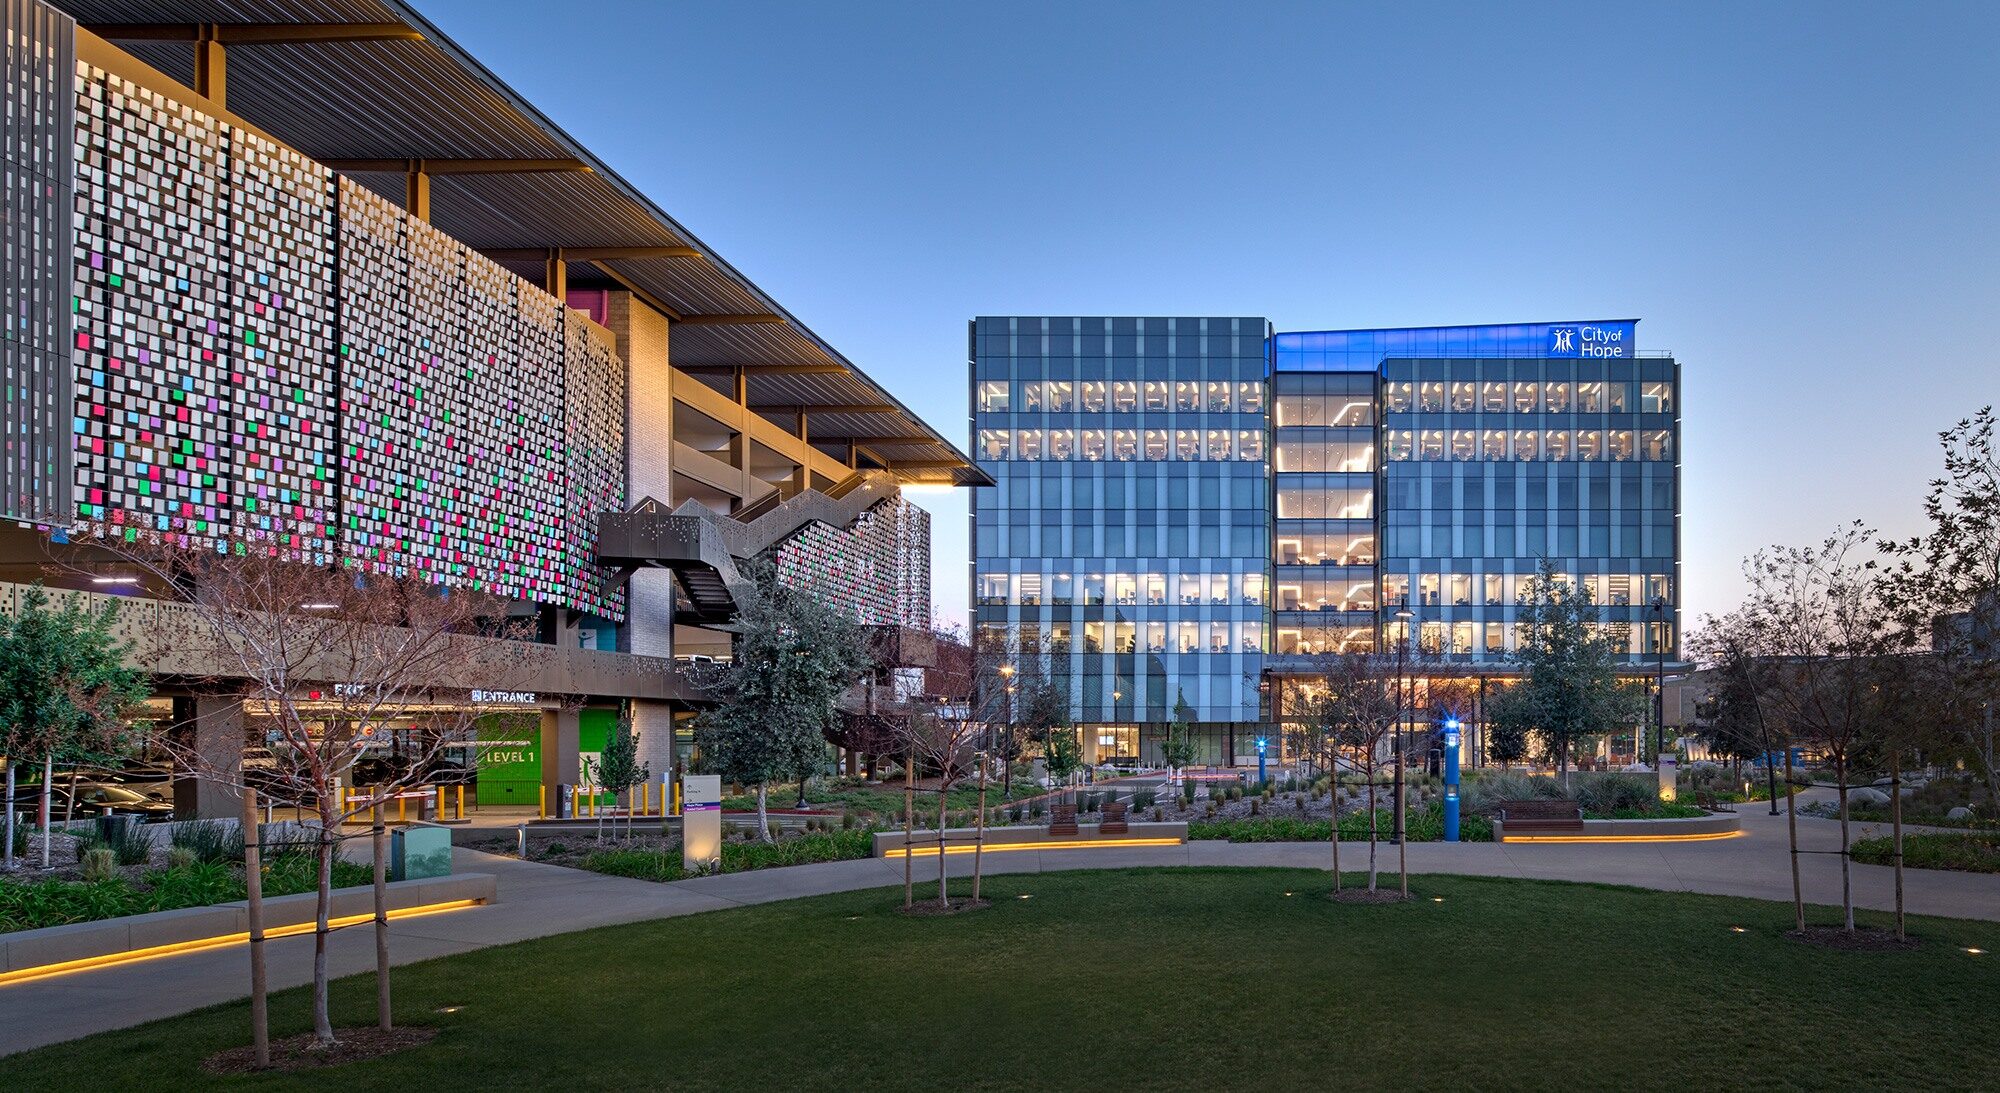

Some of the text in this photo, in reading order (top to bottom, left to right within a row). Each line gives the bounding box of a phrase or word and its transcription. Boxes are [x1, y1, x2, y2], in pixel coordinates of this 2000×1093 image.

[1581, 326, 1622, 345] City of
[1581, 343, 1622, 359] Hope
[482, 691, 535, 703] ENTRANCE
[487, 752, 534, 763] LEVEL 1
